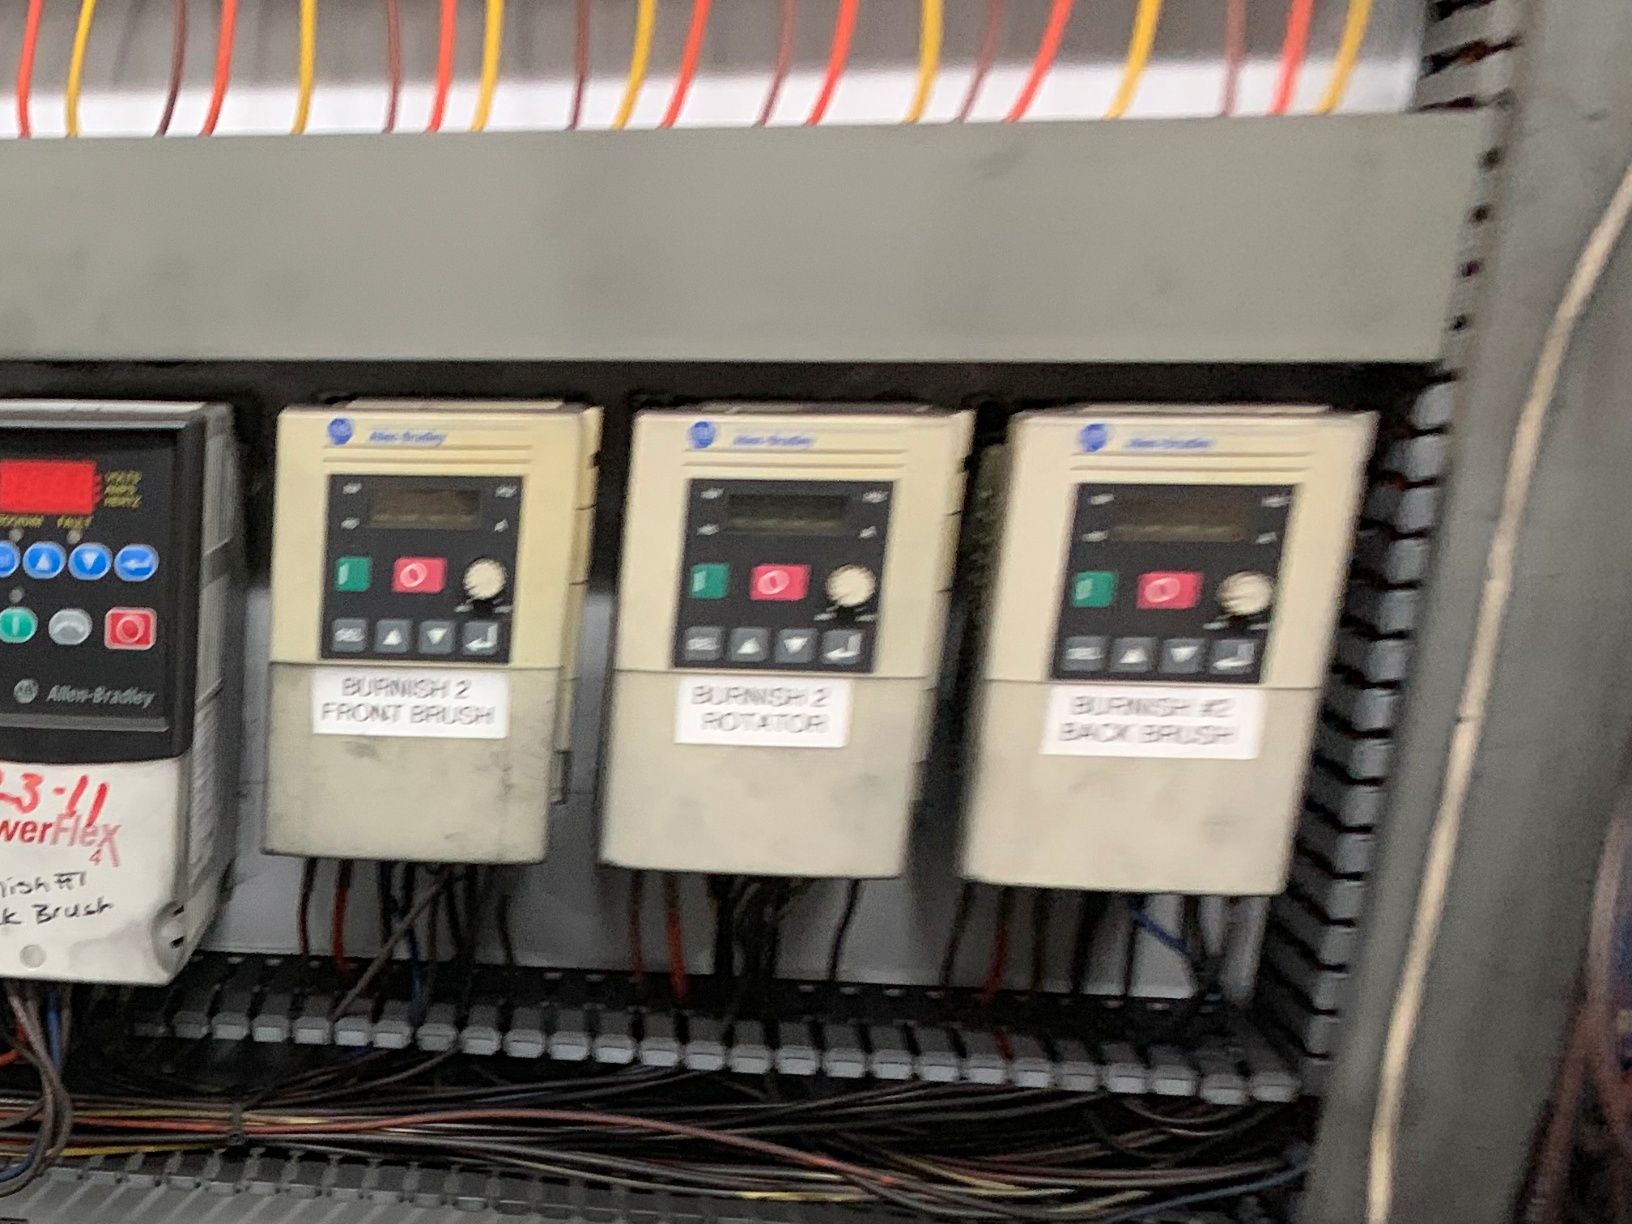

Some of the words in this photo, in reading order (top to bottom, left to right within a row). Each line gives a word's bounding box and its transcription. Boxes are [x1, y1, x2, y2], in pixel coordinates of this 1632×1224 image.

[46, 684, 156, 708] Allen-Bradley
[341, 677, 447, 698] BURNISH
[455, 678, 472, 700] 2
[691, 685, 806, 708] BURNISH
[811, 687, 832, 709] 2
[321, 702, 402, 723] FRONT
[410, 704, 496, 726] BRUSH
[701, 712, 829, 734] ROTATOR
[89, 850, 101, 865] 4
[32, 900, 115, 924] Brush
